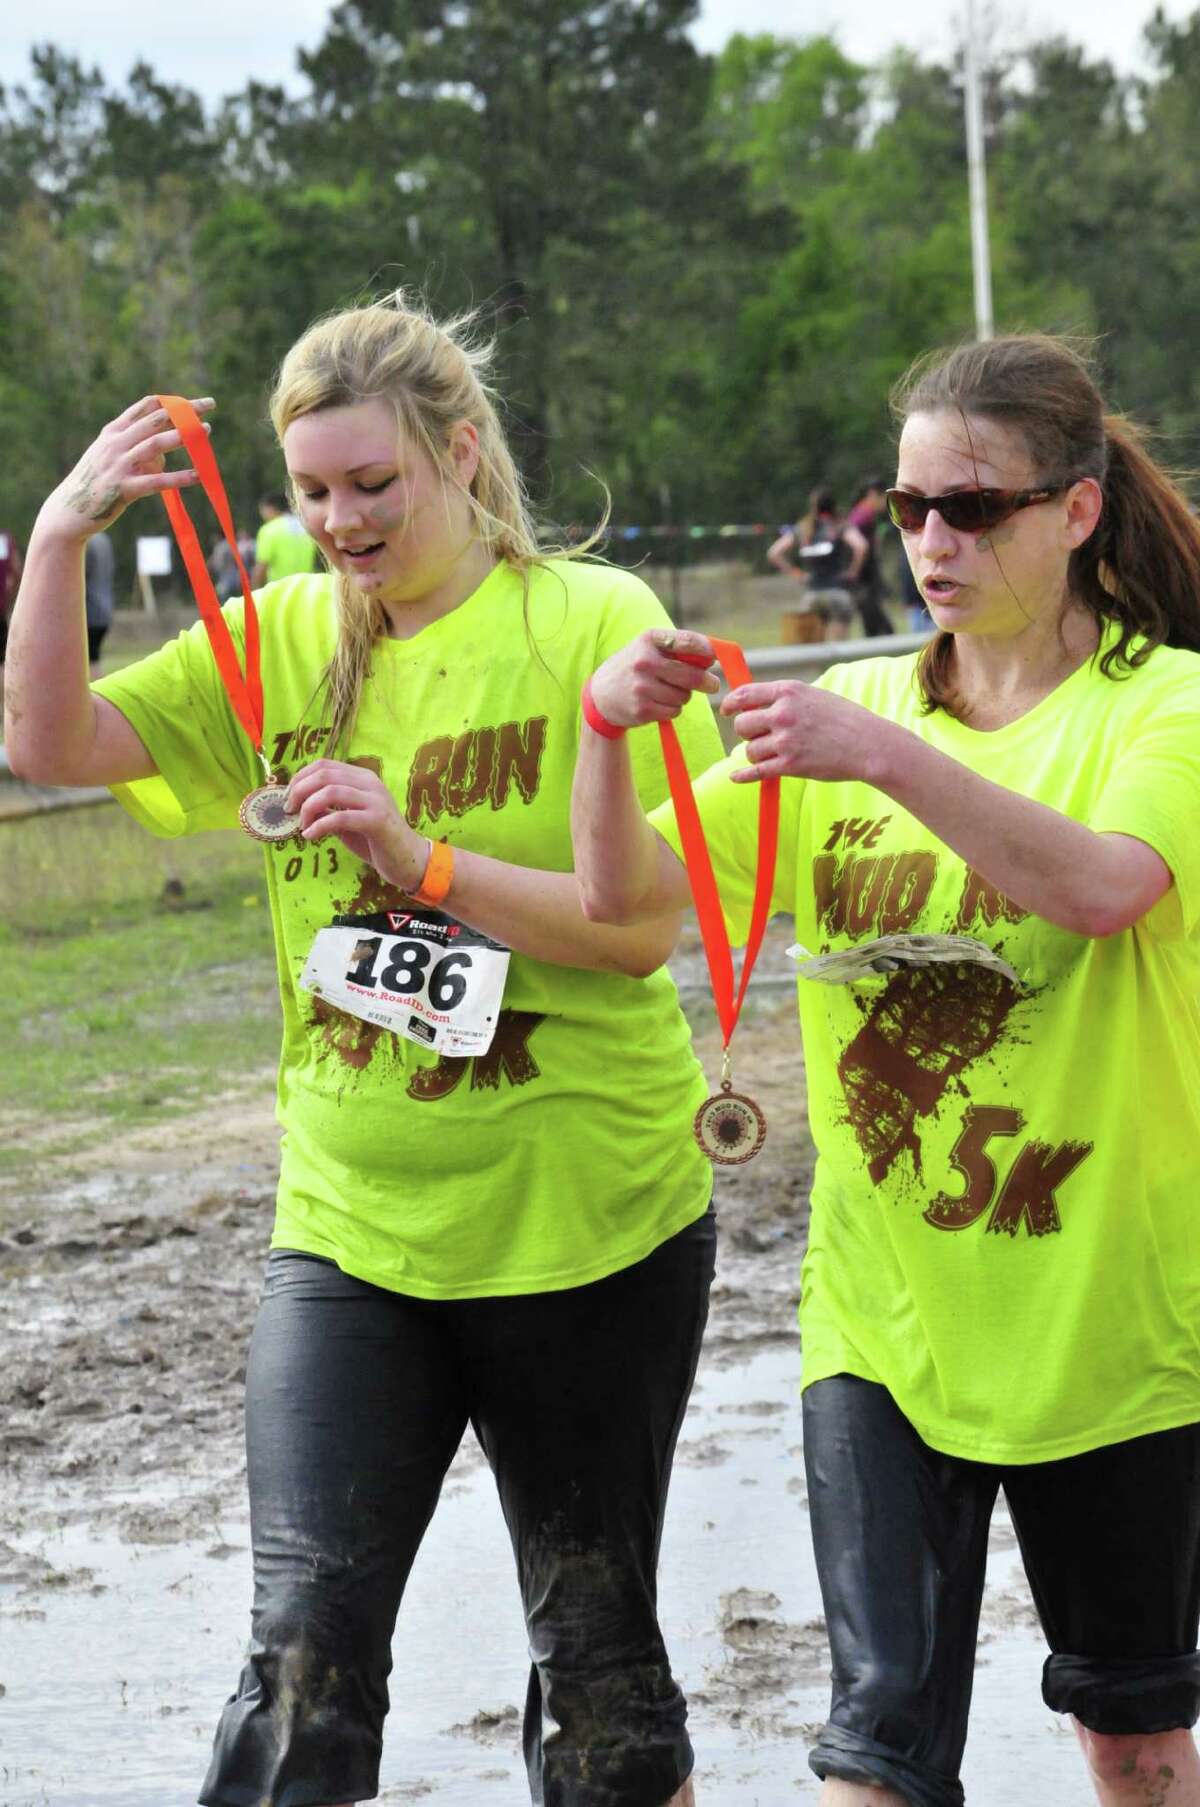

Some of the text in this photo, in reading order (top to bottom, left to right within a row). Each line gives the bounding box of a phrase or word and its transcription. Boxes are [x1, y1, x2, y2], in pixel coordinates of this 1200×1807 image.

[406, 715, 549, 828] RUN
[821, 814, 893, 850] THE
[813, 849, 939, 942] MUD
[344, 936, 473, 1012] 186
[344, 983, 451, 1024] www.RoadID.com
[921, 1103, 1095, 1238] 5K
